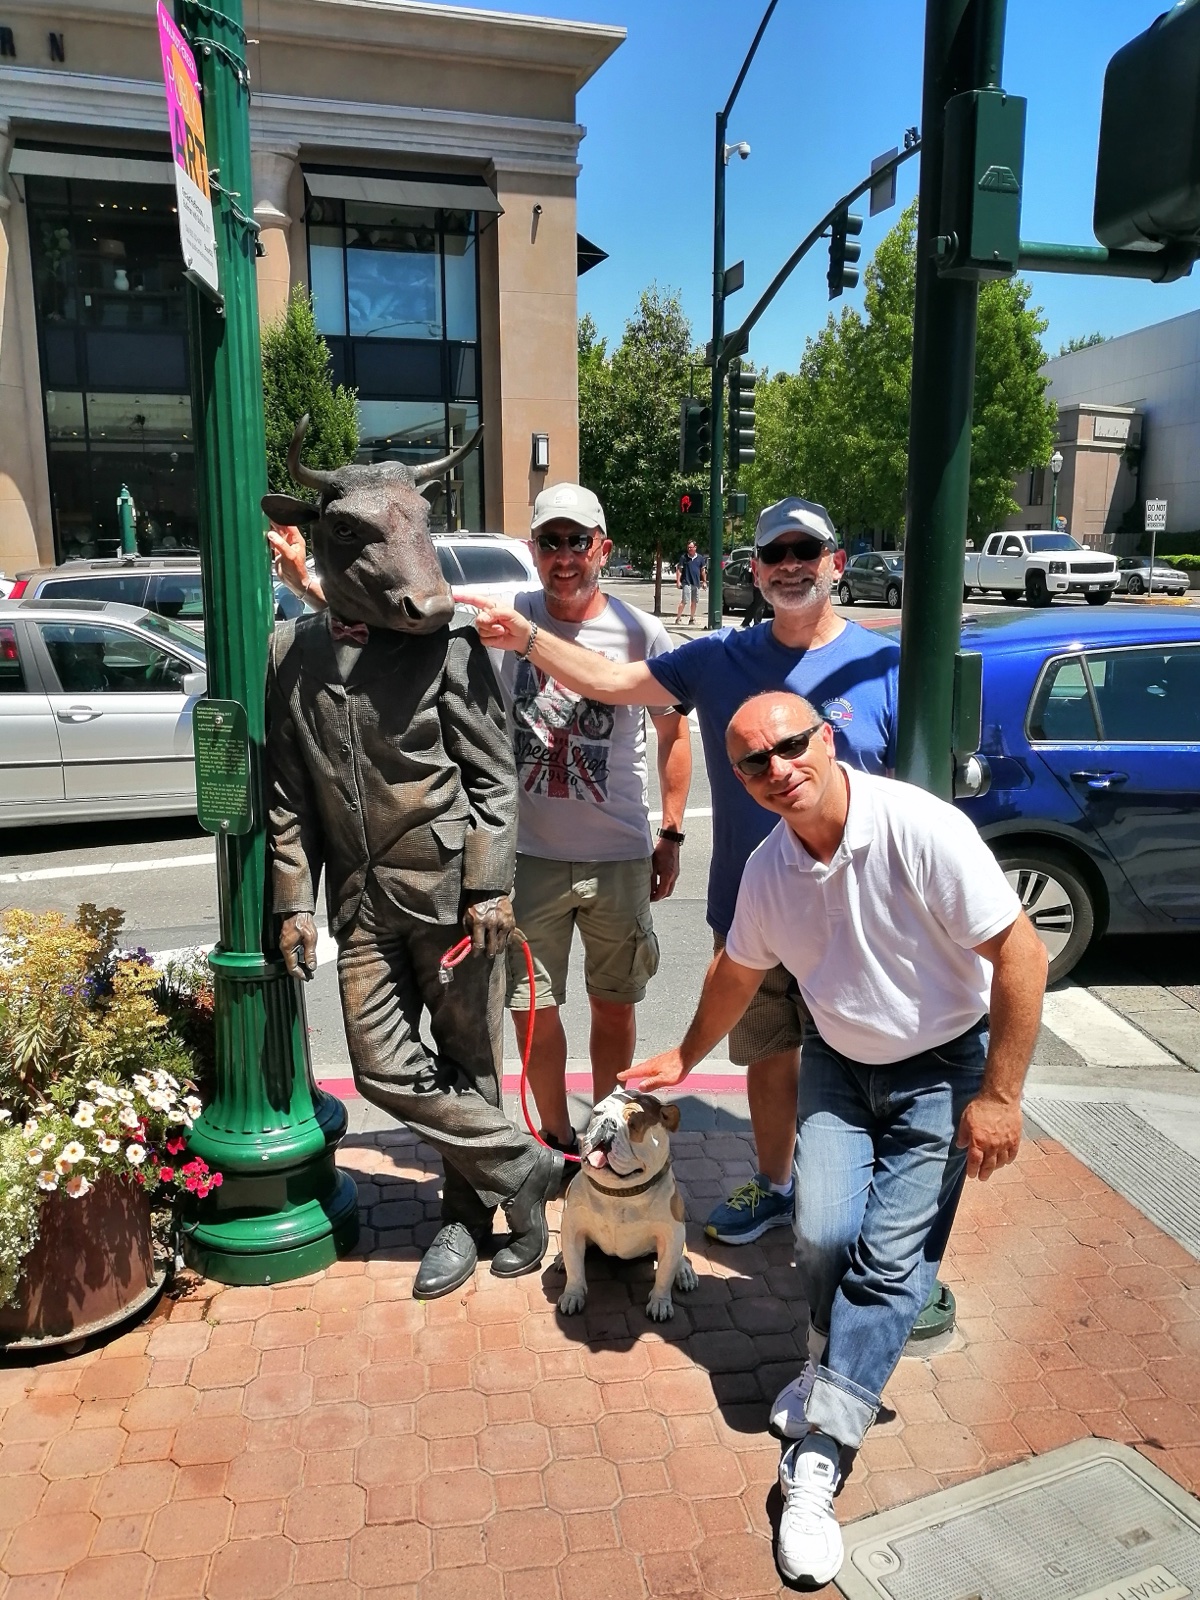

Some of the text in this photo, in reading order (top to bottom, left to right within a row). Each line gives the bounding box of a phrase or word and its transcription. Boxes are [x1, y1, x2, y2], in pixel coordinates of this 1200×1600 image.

[166, 55, 202, 133] PUBLIC
[174, 107, 207, 198] ART
[1147, 513, 1166, 521] BLOCK
[514, 732, 608, 778] Speed Shop
[816, 1461, 830, 1471] NIKE
